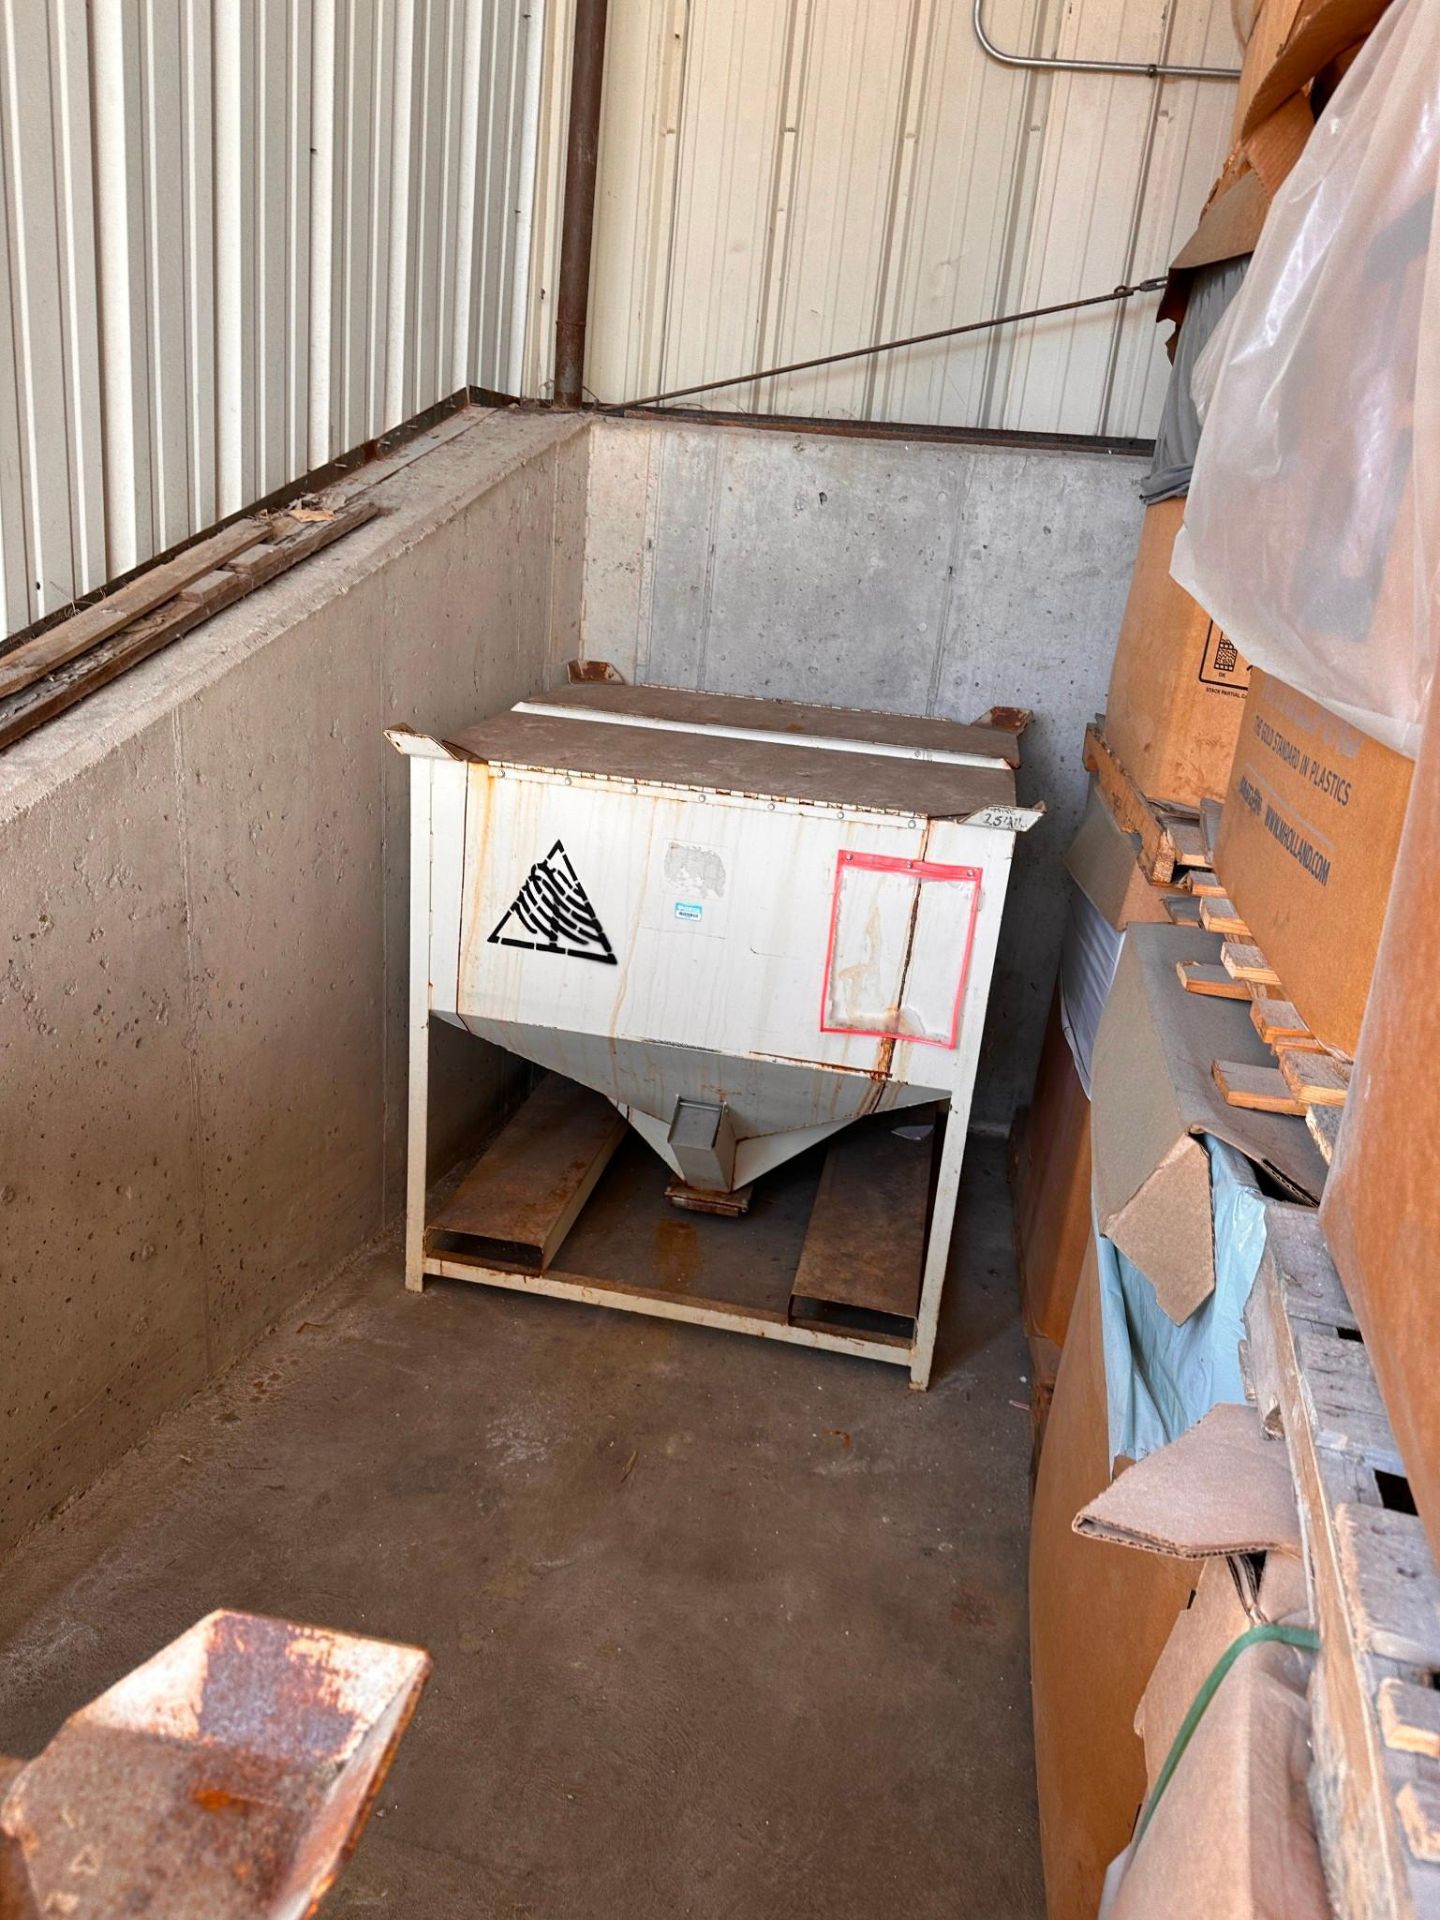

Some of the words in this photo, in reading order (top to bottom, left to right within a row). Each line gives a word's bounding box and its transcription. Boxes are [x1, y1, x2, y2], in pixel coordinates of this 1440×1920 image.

[1261, 722, 1274, 746] GOLD
[1272, 732, 1301, 770] STANDARD
[1299, 752, 1311, 778] IN
[1309, 760, 1352, 807] PLASTICS
